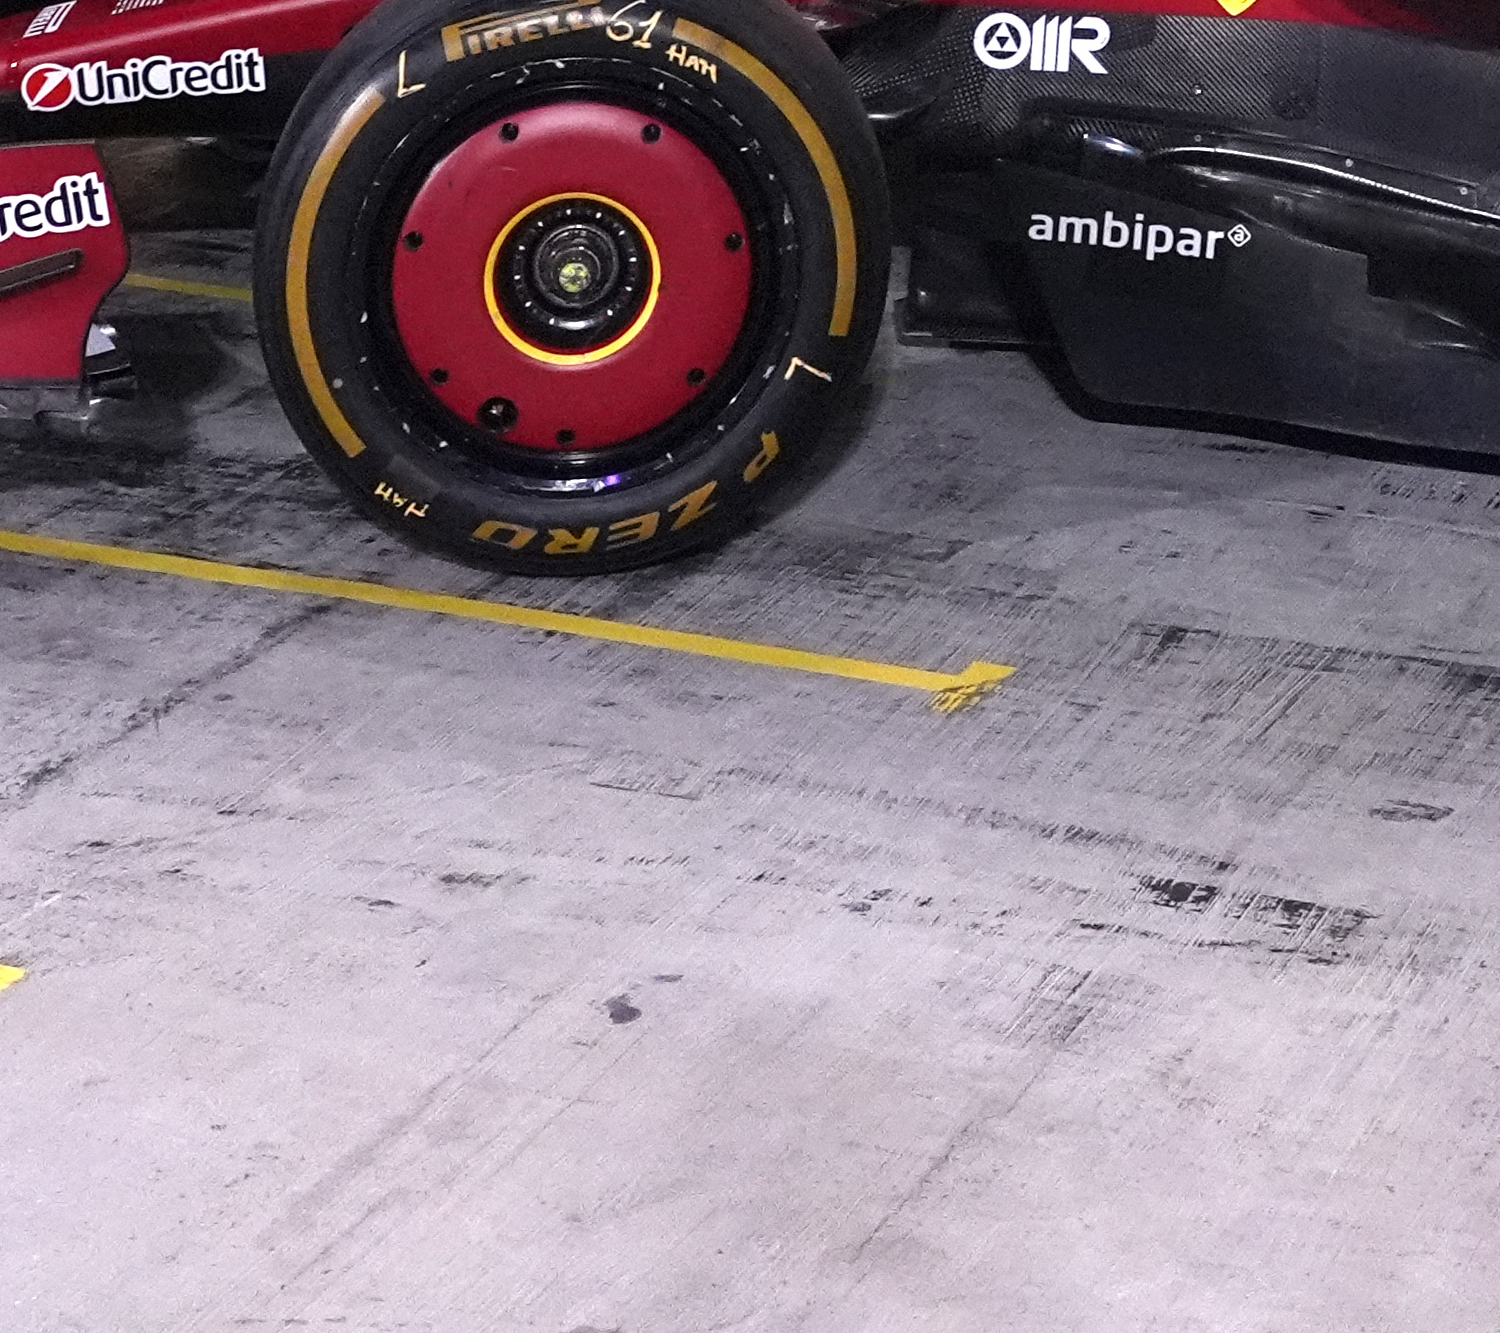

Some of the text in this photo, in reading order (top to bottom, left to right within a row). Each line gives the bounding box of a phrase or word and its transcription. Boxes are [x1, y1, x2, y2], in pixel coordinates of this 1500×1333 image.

[73, 46, 266, 105] UniCredit
[1028, 209, 1226, 261] ambipar
[472, 479, 718, 556] ZERO
